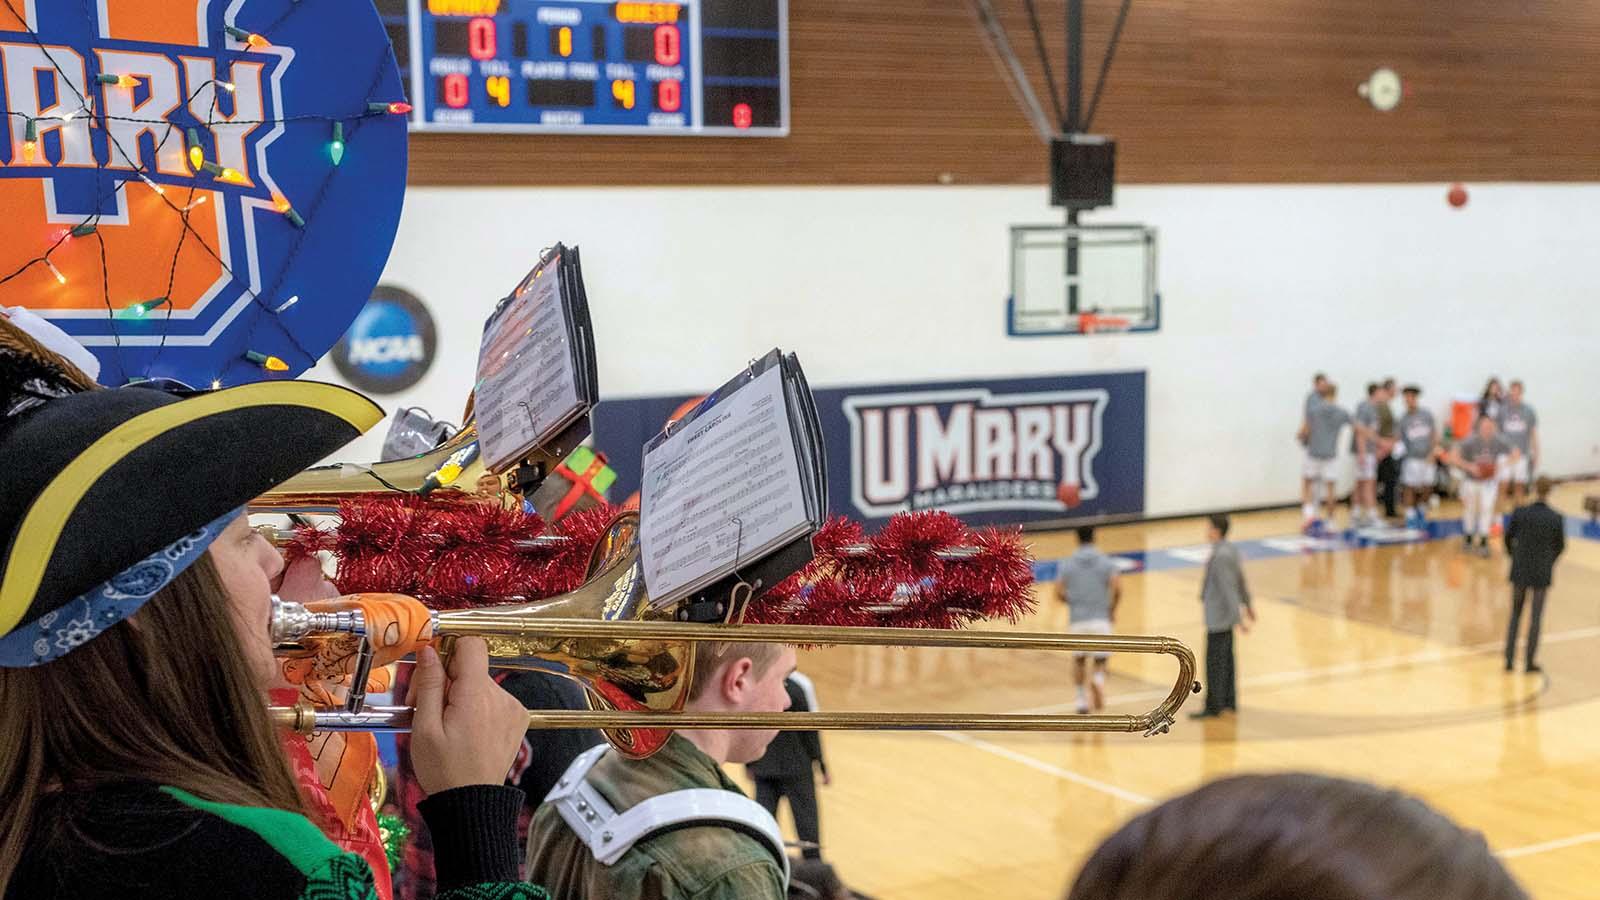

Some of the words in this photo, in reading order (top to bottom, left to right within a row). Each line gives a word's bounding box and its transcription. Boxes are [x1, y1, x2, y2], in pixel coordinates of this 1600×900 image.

[469, 17, 496, 61] 0
[559, 26, 573, 57] 1
[654, 24, 680, 66] 0
[444, 73, 470, 109] 0
[486, 75, 511, 107] 4
[612, 79, 635, 110] 4
[658, 79, 681, 112] 0
